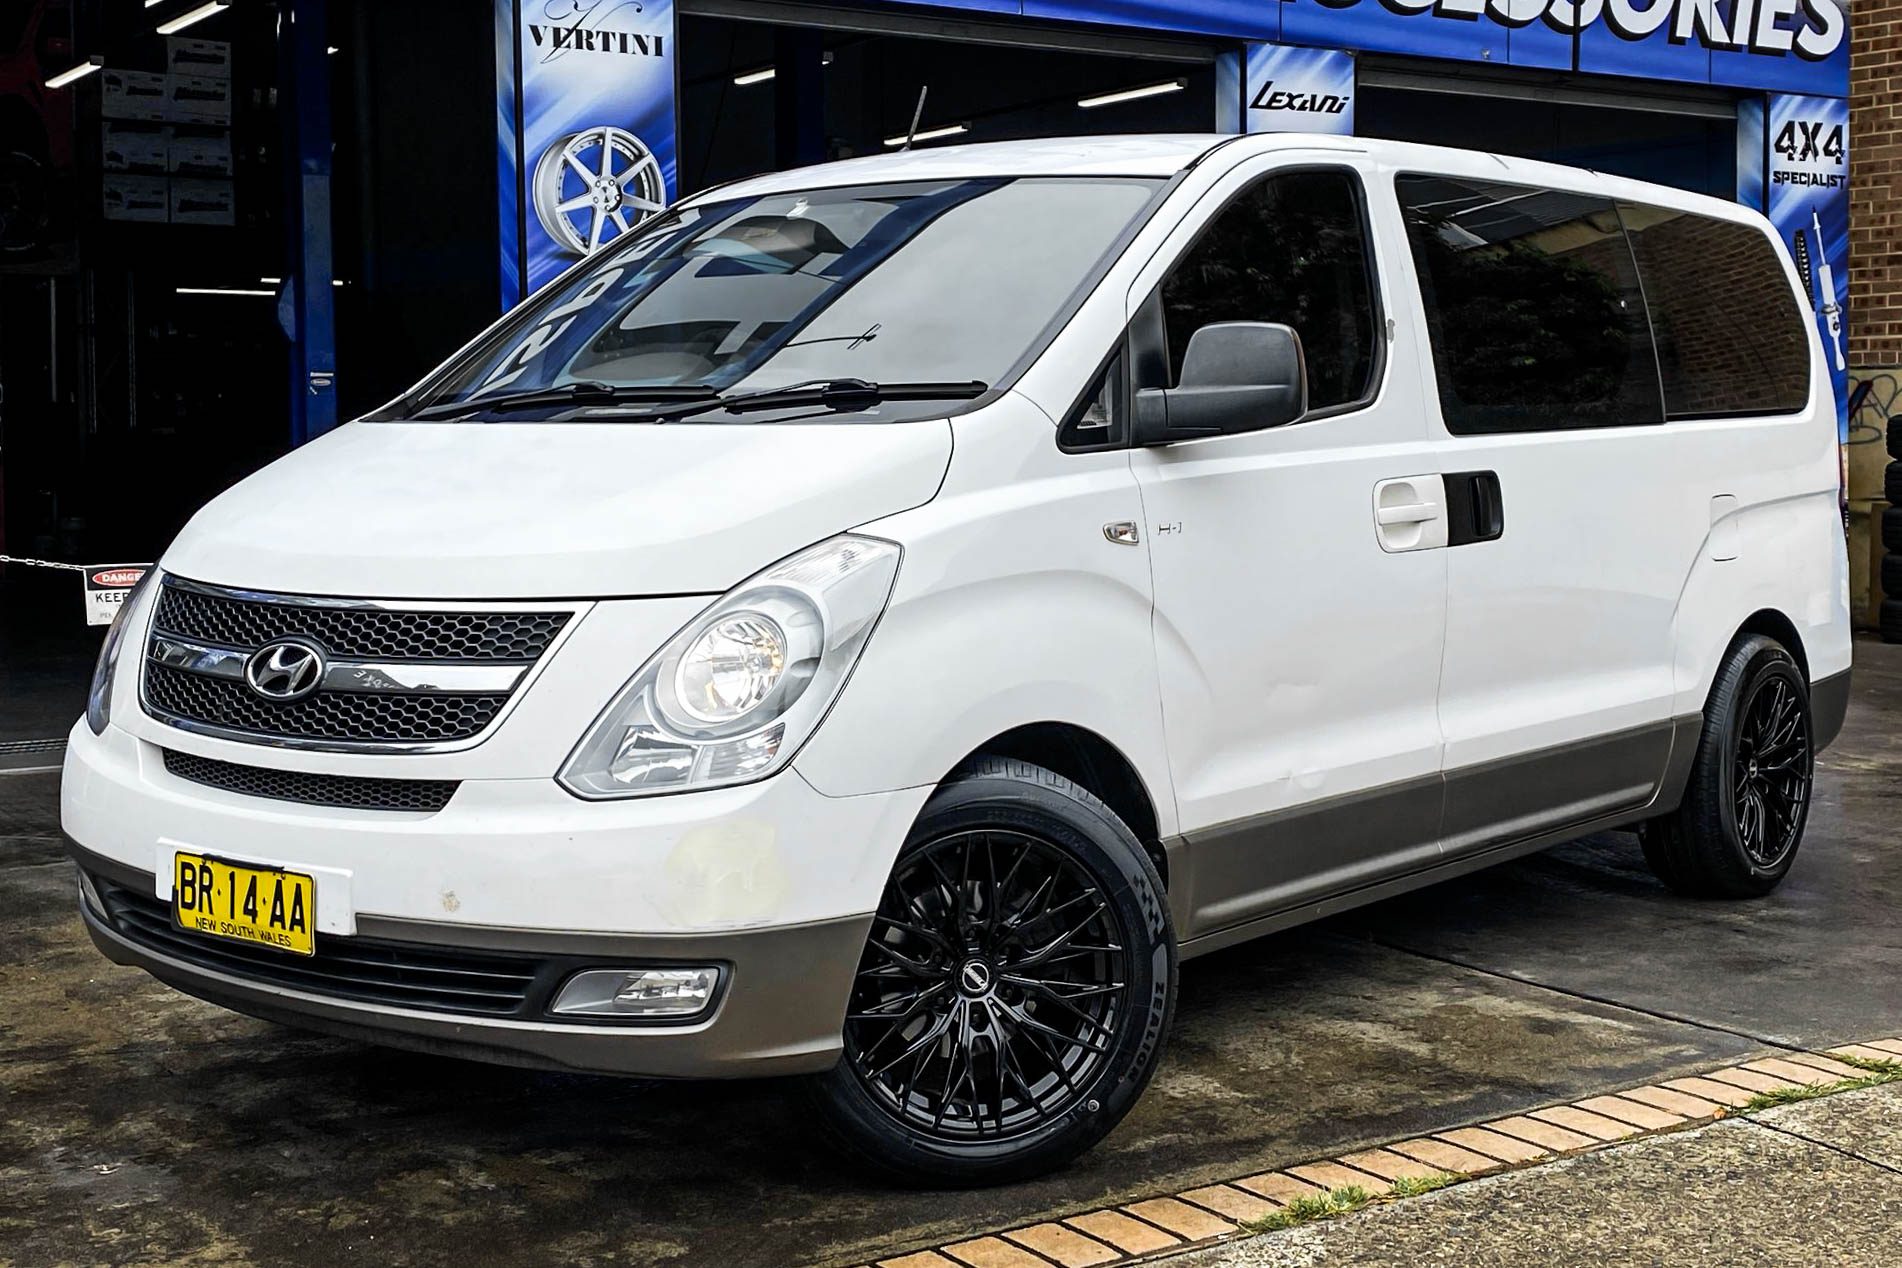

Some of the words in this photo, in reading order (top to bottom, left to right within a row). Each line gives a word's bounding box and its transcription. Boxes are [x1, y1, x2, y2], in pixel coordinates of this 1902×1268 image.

[528, 24, 665, 57] VERTINI
[1774, 120, 1846, 165] 4X4
[1773, 170, 1847, 190] SPECIALIST
[101, 573, 144, 582] DANGE
[195, 917, 217, 931] NEW
[221, 921, 255, 939] SOUTH
[260, 930, 292, 947] WALES
